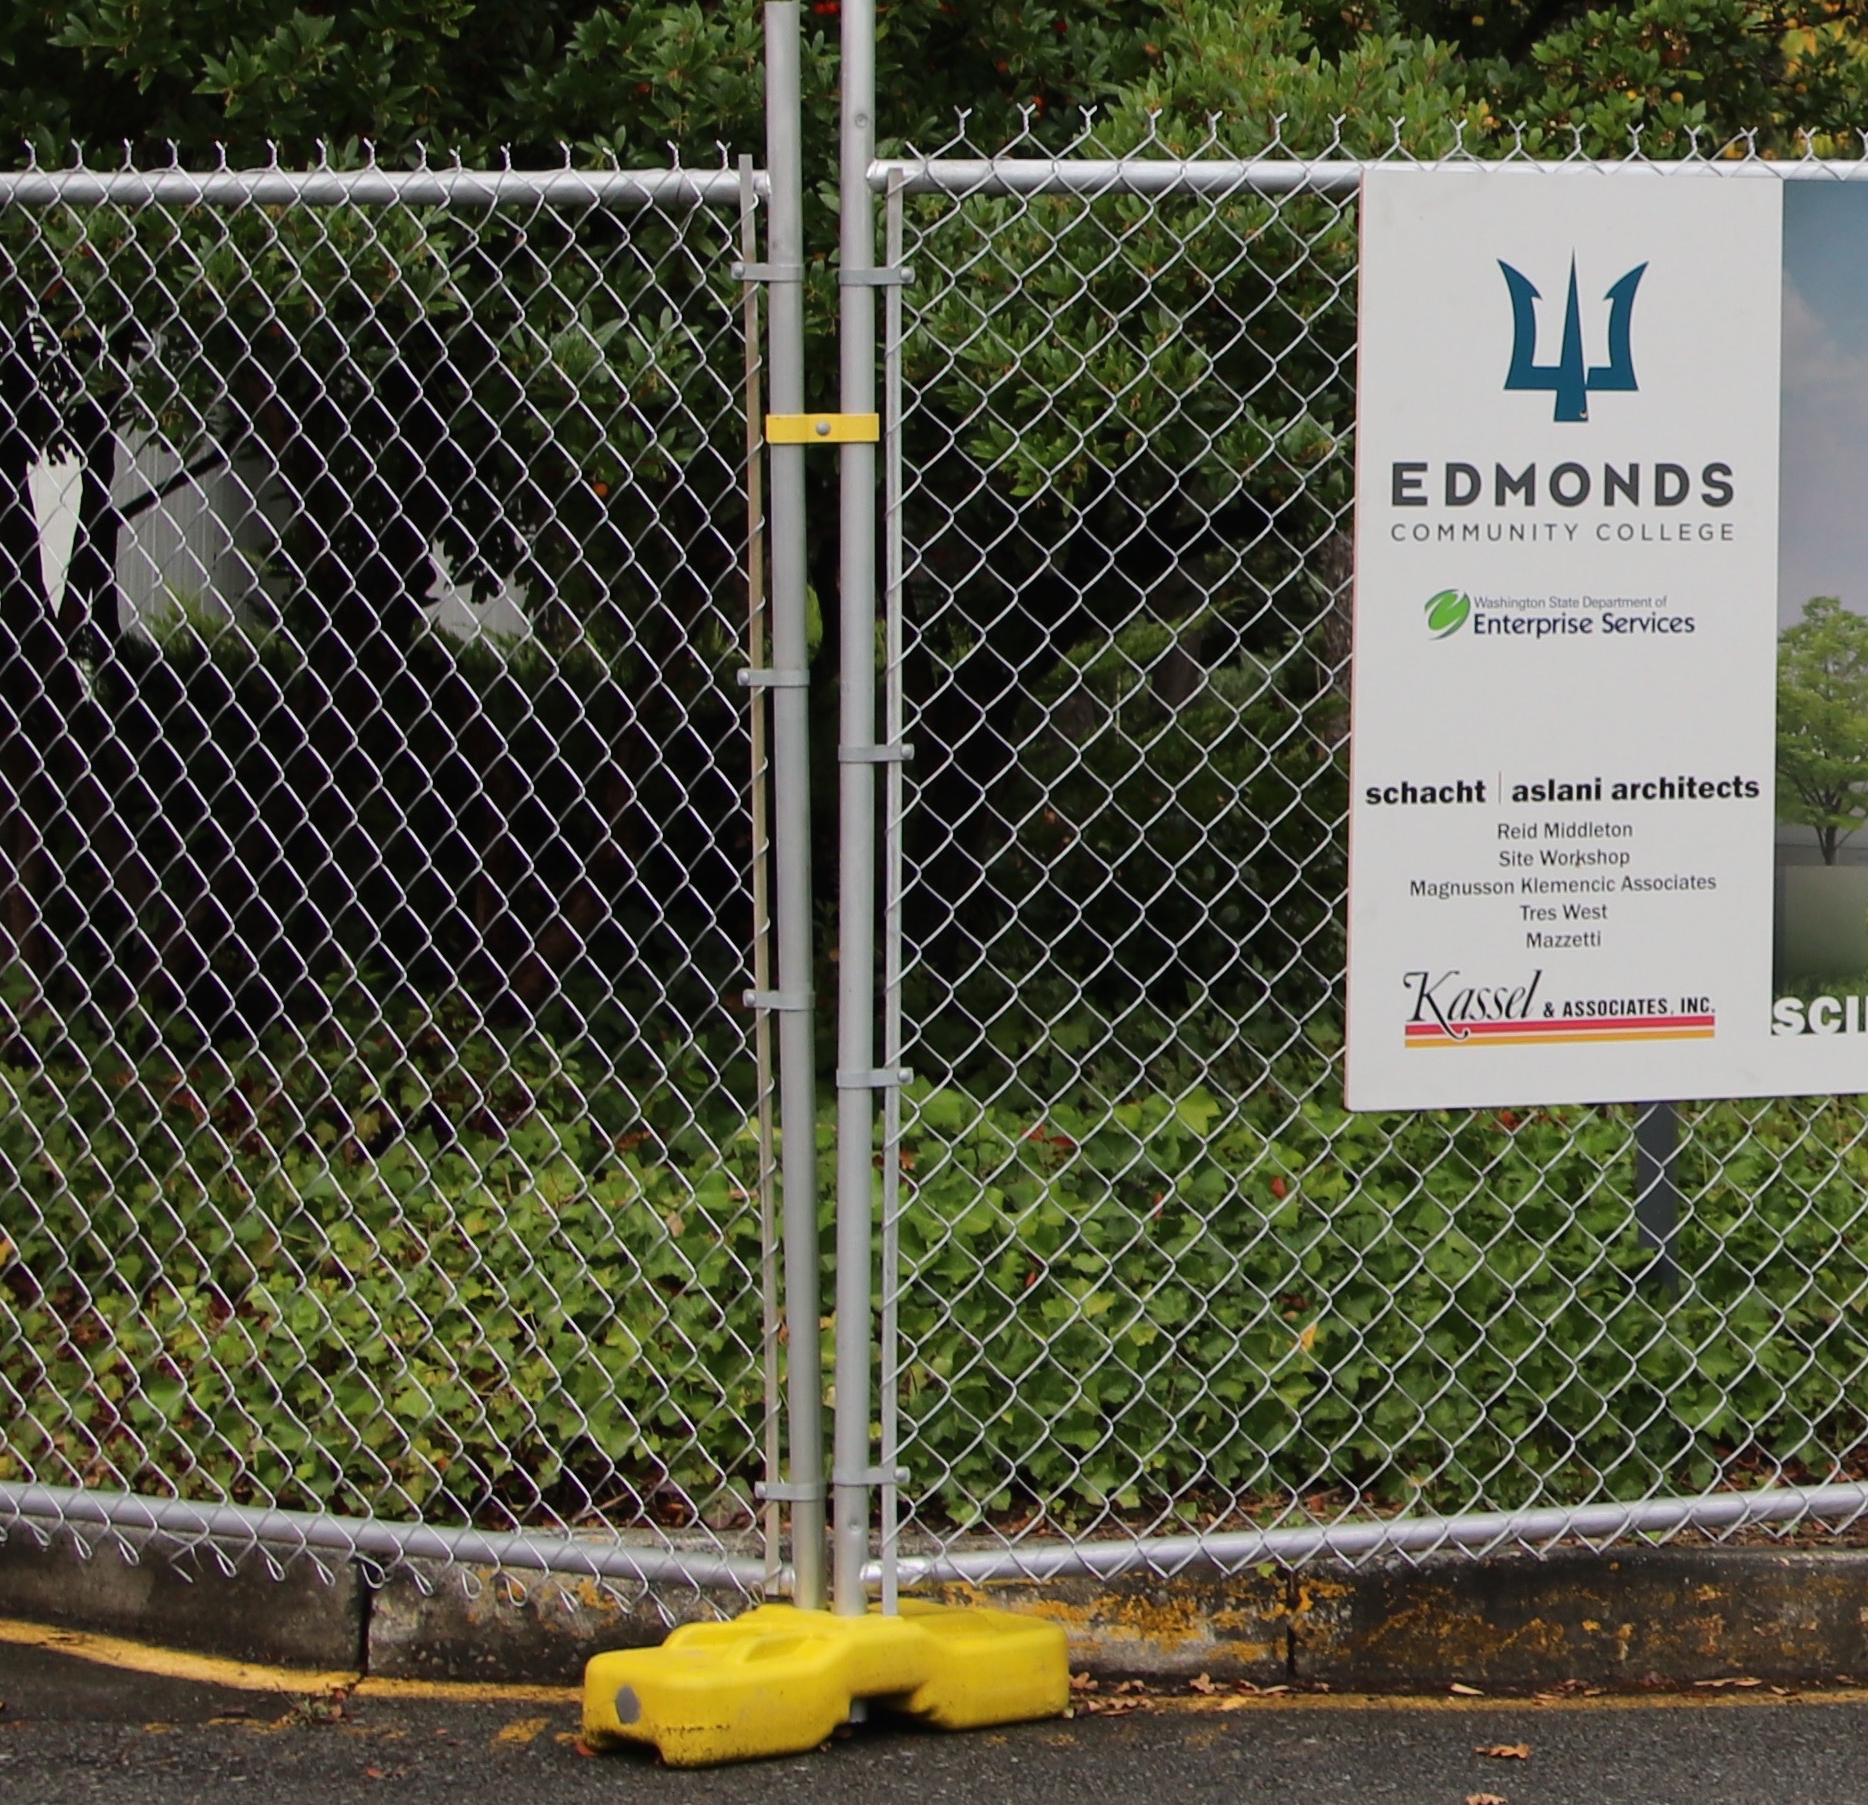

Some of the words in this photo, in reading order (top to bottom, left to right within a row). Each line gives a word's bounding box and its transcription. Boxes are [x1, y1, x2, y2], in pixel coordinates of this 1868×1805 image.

[1392, 462, 1734, 507] EDMONDS
[1391, 524, 1577, 541] COMMUNITY
[1596, 523, 1733, 541] COLLEGE
[1474, 596, 1545, 611] Washington
[1549, 596, 1579, 608] State
[1583, 596, 1652, 611] Department
[1655, 596, 1667, 607] of
[1474, 613, 1593, 639] Enterprise
[1602, 612, 1695, 633] Services
[1366, 780, 1485, 805] schacht
[1512, 778, 1601, 802] aslani
[1612, 776, 1759, 800] architects
[1498, 823, 1537, 839] Reid
[1545, 822, 1632, 838] Middleton
[1499, 851, 1533, 867] Site
[1540, 849, 1630, 867] Workshop
[1411, 880, 1514, 899] Magnusson
[1522, 876, 1615, 893] Klemencic
[1621, 875, 1716, 891] Associates
[1520, 905, 1556, 920] Tres
[1563, 904, 1606, 919] West
[1527, 931, 1600, 948] Mazzetti
[1403, 970, 1542, 1039] Kassel
[1544, 1003, 1554, 1017] &
[1680, 996, 1716, 1014] INC.
